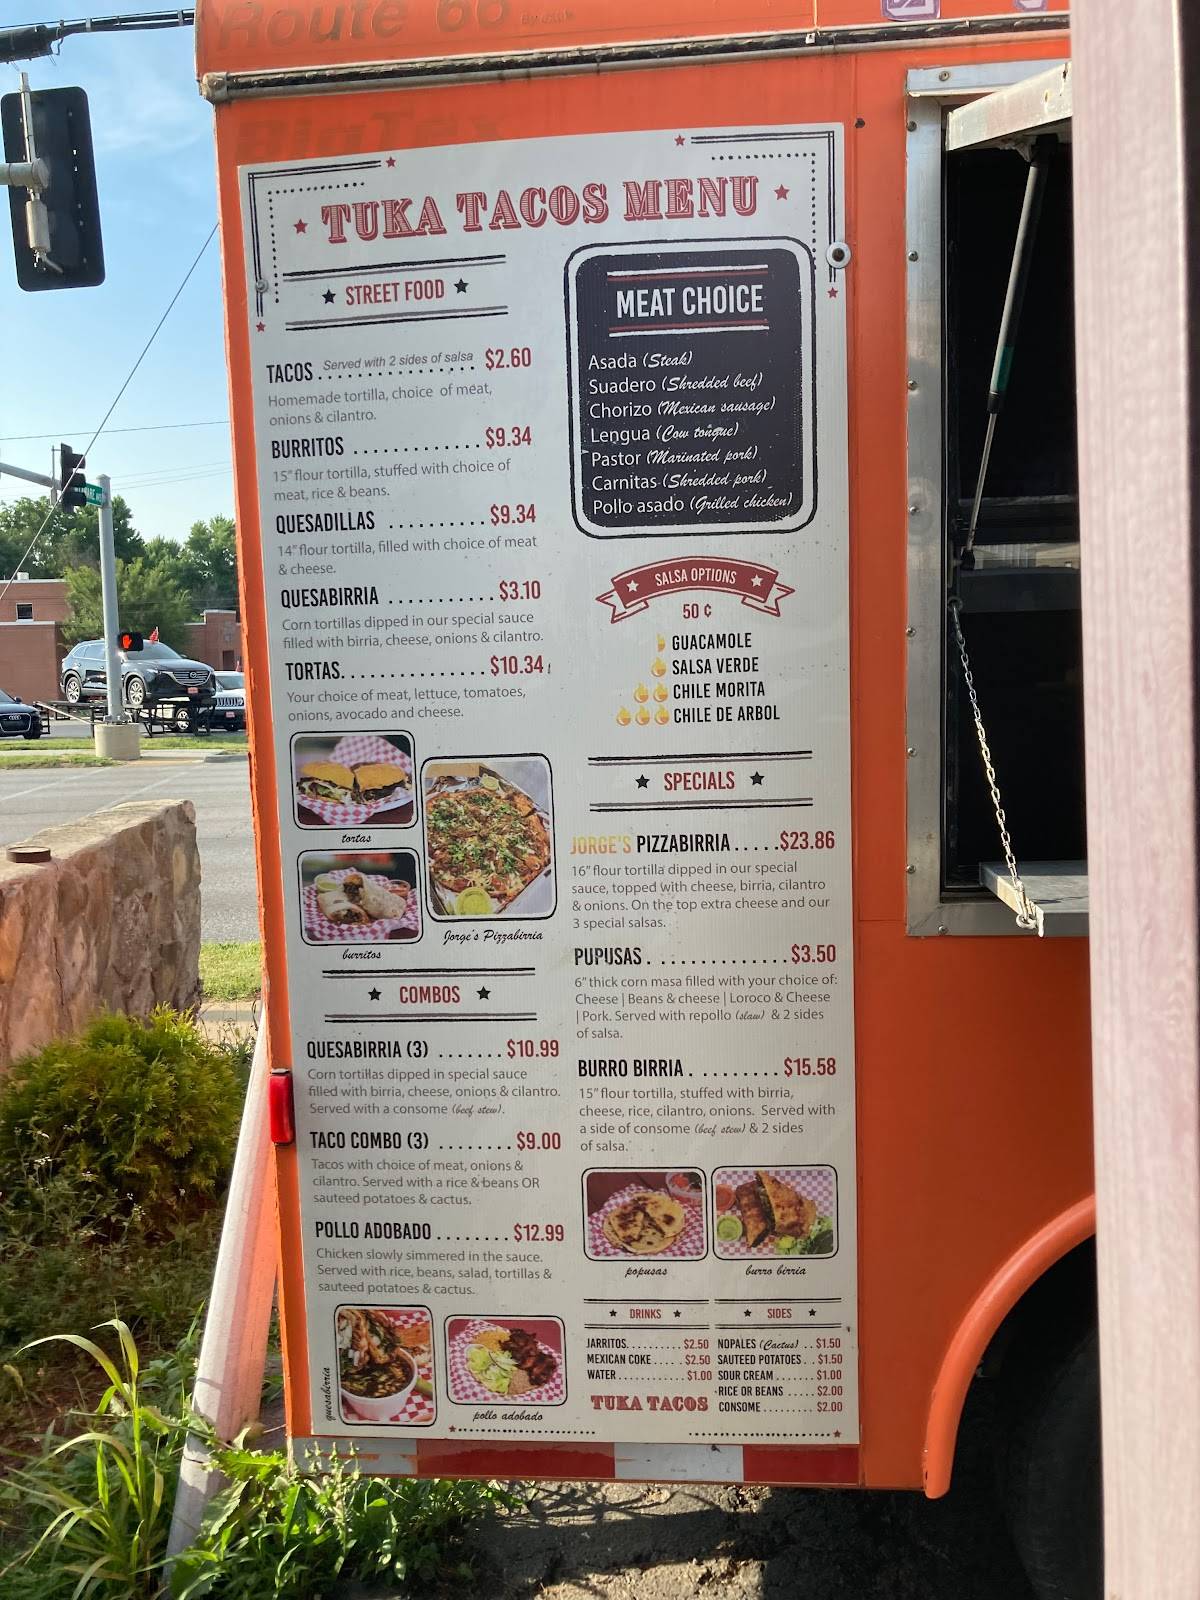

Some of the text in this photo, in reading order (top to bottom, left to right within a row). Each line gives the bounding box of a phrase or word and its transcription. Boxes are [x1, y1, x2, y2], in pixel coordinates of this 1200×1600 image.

[321, 175, 759, 244] TUKA TACOS MENU
[345, 279, 445, 305] STREET FOOD
[617, 284, 763, 318] MEAT CHOICE
[266, 348, 532, 383] TACOS Served with 2 sides of salsa $2.60
[589, 351, 693, 370] Asada (Steak)
[589, 372, 763, 394] Suadero (Shredded beef)
[269, 382, 492, 407] Homemade tortilla, choice of meat,
[589, 396, 775, 418] Chorizo (Mexican sausage)
[270, 410, 376, 426] onions & cilantro.
[272, 426, 532, 459] BURRITOS $9.34
[591, 427, 650, 445] Lengua
[657, 424, 689, 441] (Cow
[592, 446, 758, 466] Pastor (Marinated pork)
[592, 469, 767, 491] Carnitas (Shredded pork)
[594, 492, 793, 515] Pollo asado (Grilled chicken)
[276, 504, 536, 534] QUESADILLAS $9.34
[655, 568, 737, 586] SALSA OPTIONS
[281, 580, 540, 608] QUESABIRRIA $3.10
[683, 603, 712, 619] 50 ¢
[672, 633, 752, 650] GUACAMOLE
[286, 655, 544, 680] TORTAS $10.34
[672, 657, 759, 675] SALSA VERDE
[287, 686, 526, 703] Your choice of meat, lettuce, tomatoes,
[673, 681, 765, 699] CHILE MORITA
[288, 706, 464, 722] onions, avocado and cheese.
[674, 705, 780, 723] CHILE DE ARBOL
[664, 771, 735, 790] SPECIALS
[342, 833, 371, 843] tortas
[570, 830, 835, 855] JORGE'S PIZZABIRRIA $23.86
[443, 929, 543, 945] Jorge's Pizzabirria
[342, 949, 381, 960] burritos
[574, 944, 836, 965] PUPUSAS $3.50
[589, 976, 618, 988] thick
[621, 977, 647, 987] corn
[651, 977, 682, 987] masa
[685, 975, 715, 987] filled
[719, 975, 744, 986] with
[748, 976, 776, 988] your
[779, 975, 818, 985] choice
[822, 974, 838, 985] of:
[400, 986, 460, 1004] COMBOS
[307, 1039, 559, 1059] QUESABIRRIA (3) $10.99
[578, 1057, 836, 1077] BURRO BIRRIA $15.58
[310, 1131, 561, 1151] TACO COMBO (3) $9.00
[314, 1193, 472, 1206] sauteed potatoes & cactus.
[315, 1222, 565, 1242] POLLO ADOBADO $12.99
[317, 1248, 543, 1262] Chicken slowly simmered in the sauce.
[625, 1266, 668, 1278] popusas
[745, 1265, 807, 1276] burro birria
[630, 1309, 661, 1319] DRINKS
[767, 1309, 792, 1319] SIDES
[587, 1339, 709, 1350] JARRITOS $2.50
[718, 1338, 841, 1350] NOPALES (Cactus) $1.50
[587, 1354, 710, 1365] MEXICAN COKE $2.50
[718, 1354, 843, 1365] SAUTEED POTATOES $1.50
[587, 1370, 712, 1381] WATER $1.00
[718, 1370, 842, 1381] SOUR CREAM $1.00
[719, 1385, 843, 1397] RICE OR BEANS $2.00
[591, 1395, 709, 1411] TUKA TACOS
[719, 1401, 842, 1412] CONSOME $2.00
[473, 1410, 543, 1421] pollo adobado
